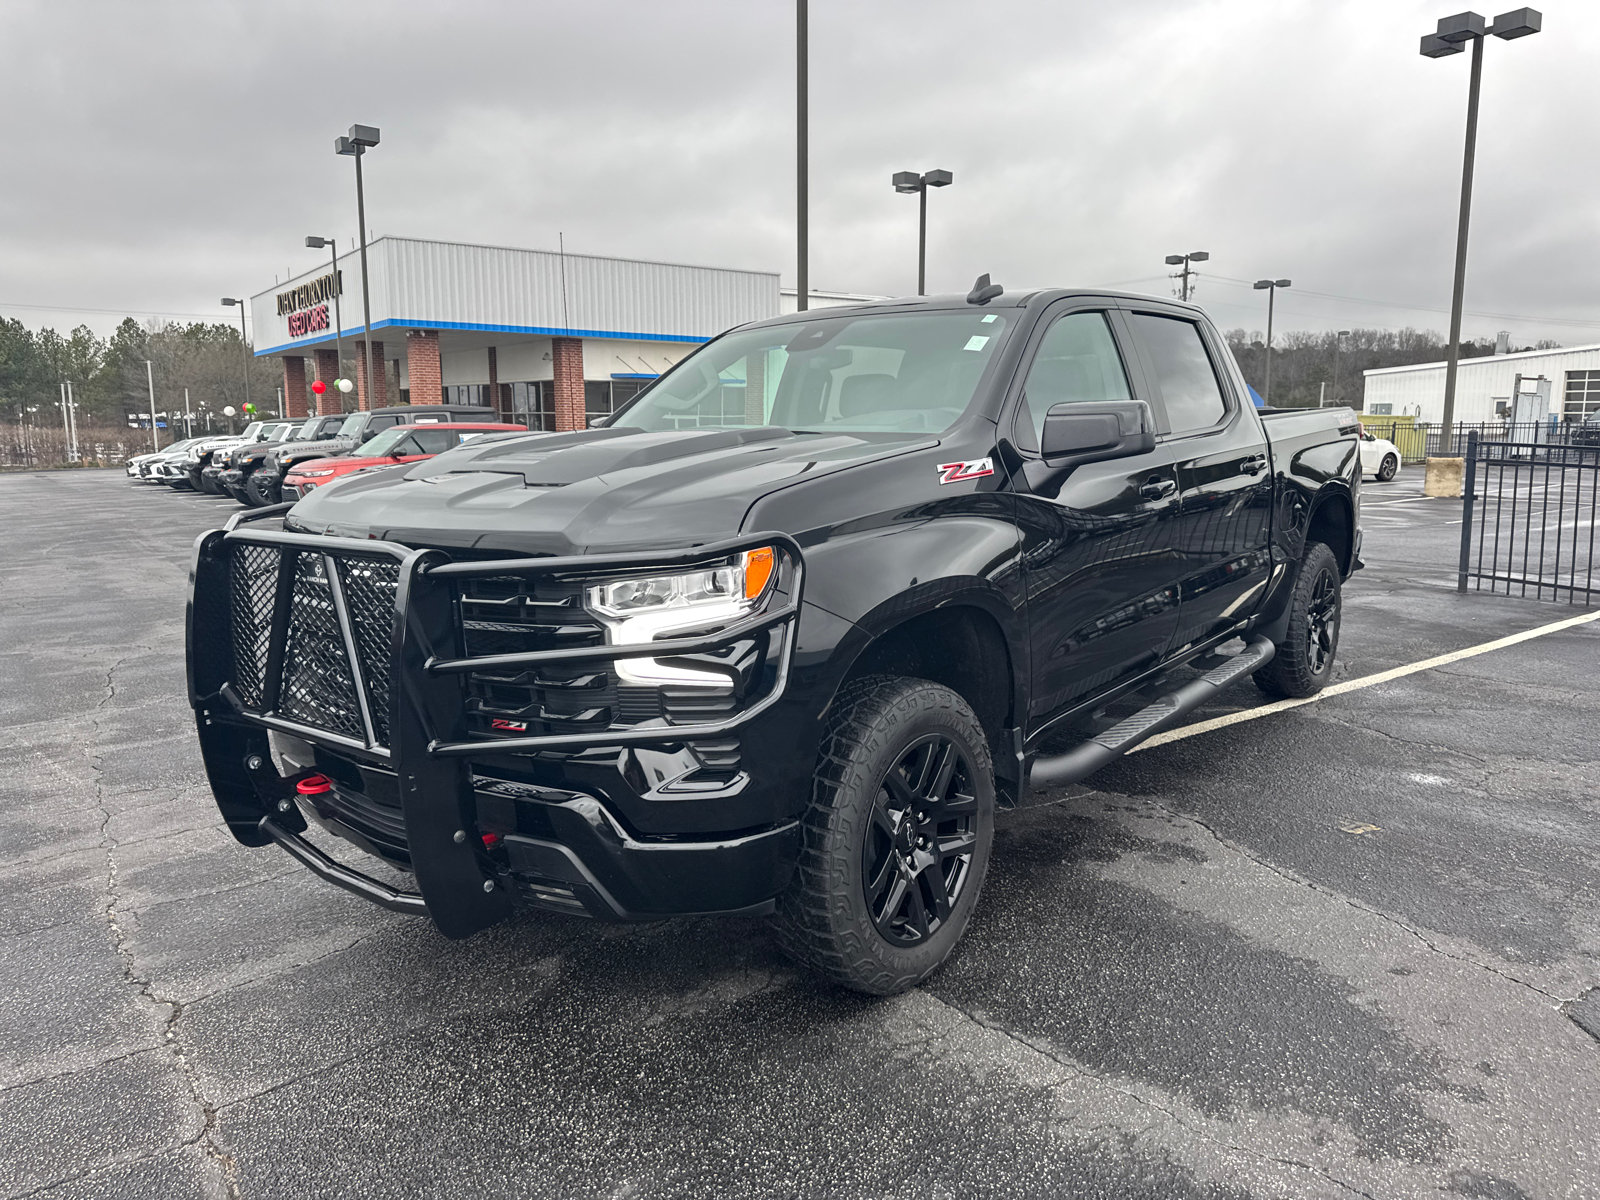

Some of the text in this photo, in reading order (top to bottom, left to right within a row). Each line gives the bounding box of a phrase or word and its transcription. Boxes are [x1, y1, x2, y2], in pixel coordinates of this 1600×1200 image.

[288, 304, 330, 337] USED CARS
[292, 444, 339, 452] RUBICON
[936, 457, 994, 485] Z71
[306, 575, 320, 583] RANCH
[491, 718, 528, 732] Z71
[930, 711, 986, 770] WRANGLER
[858, 911, 931, 972] GOODYEAR
